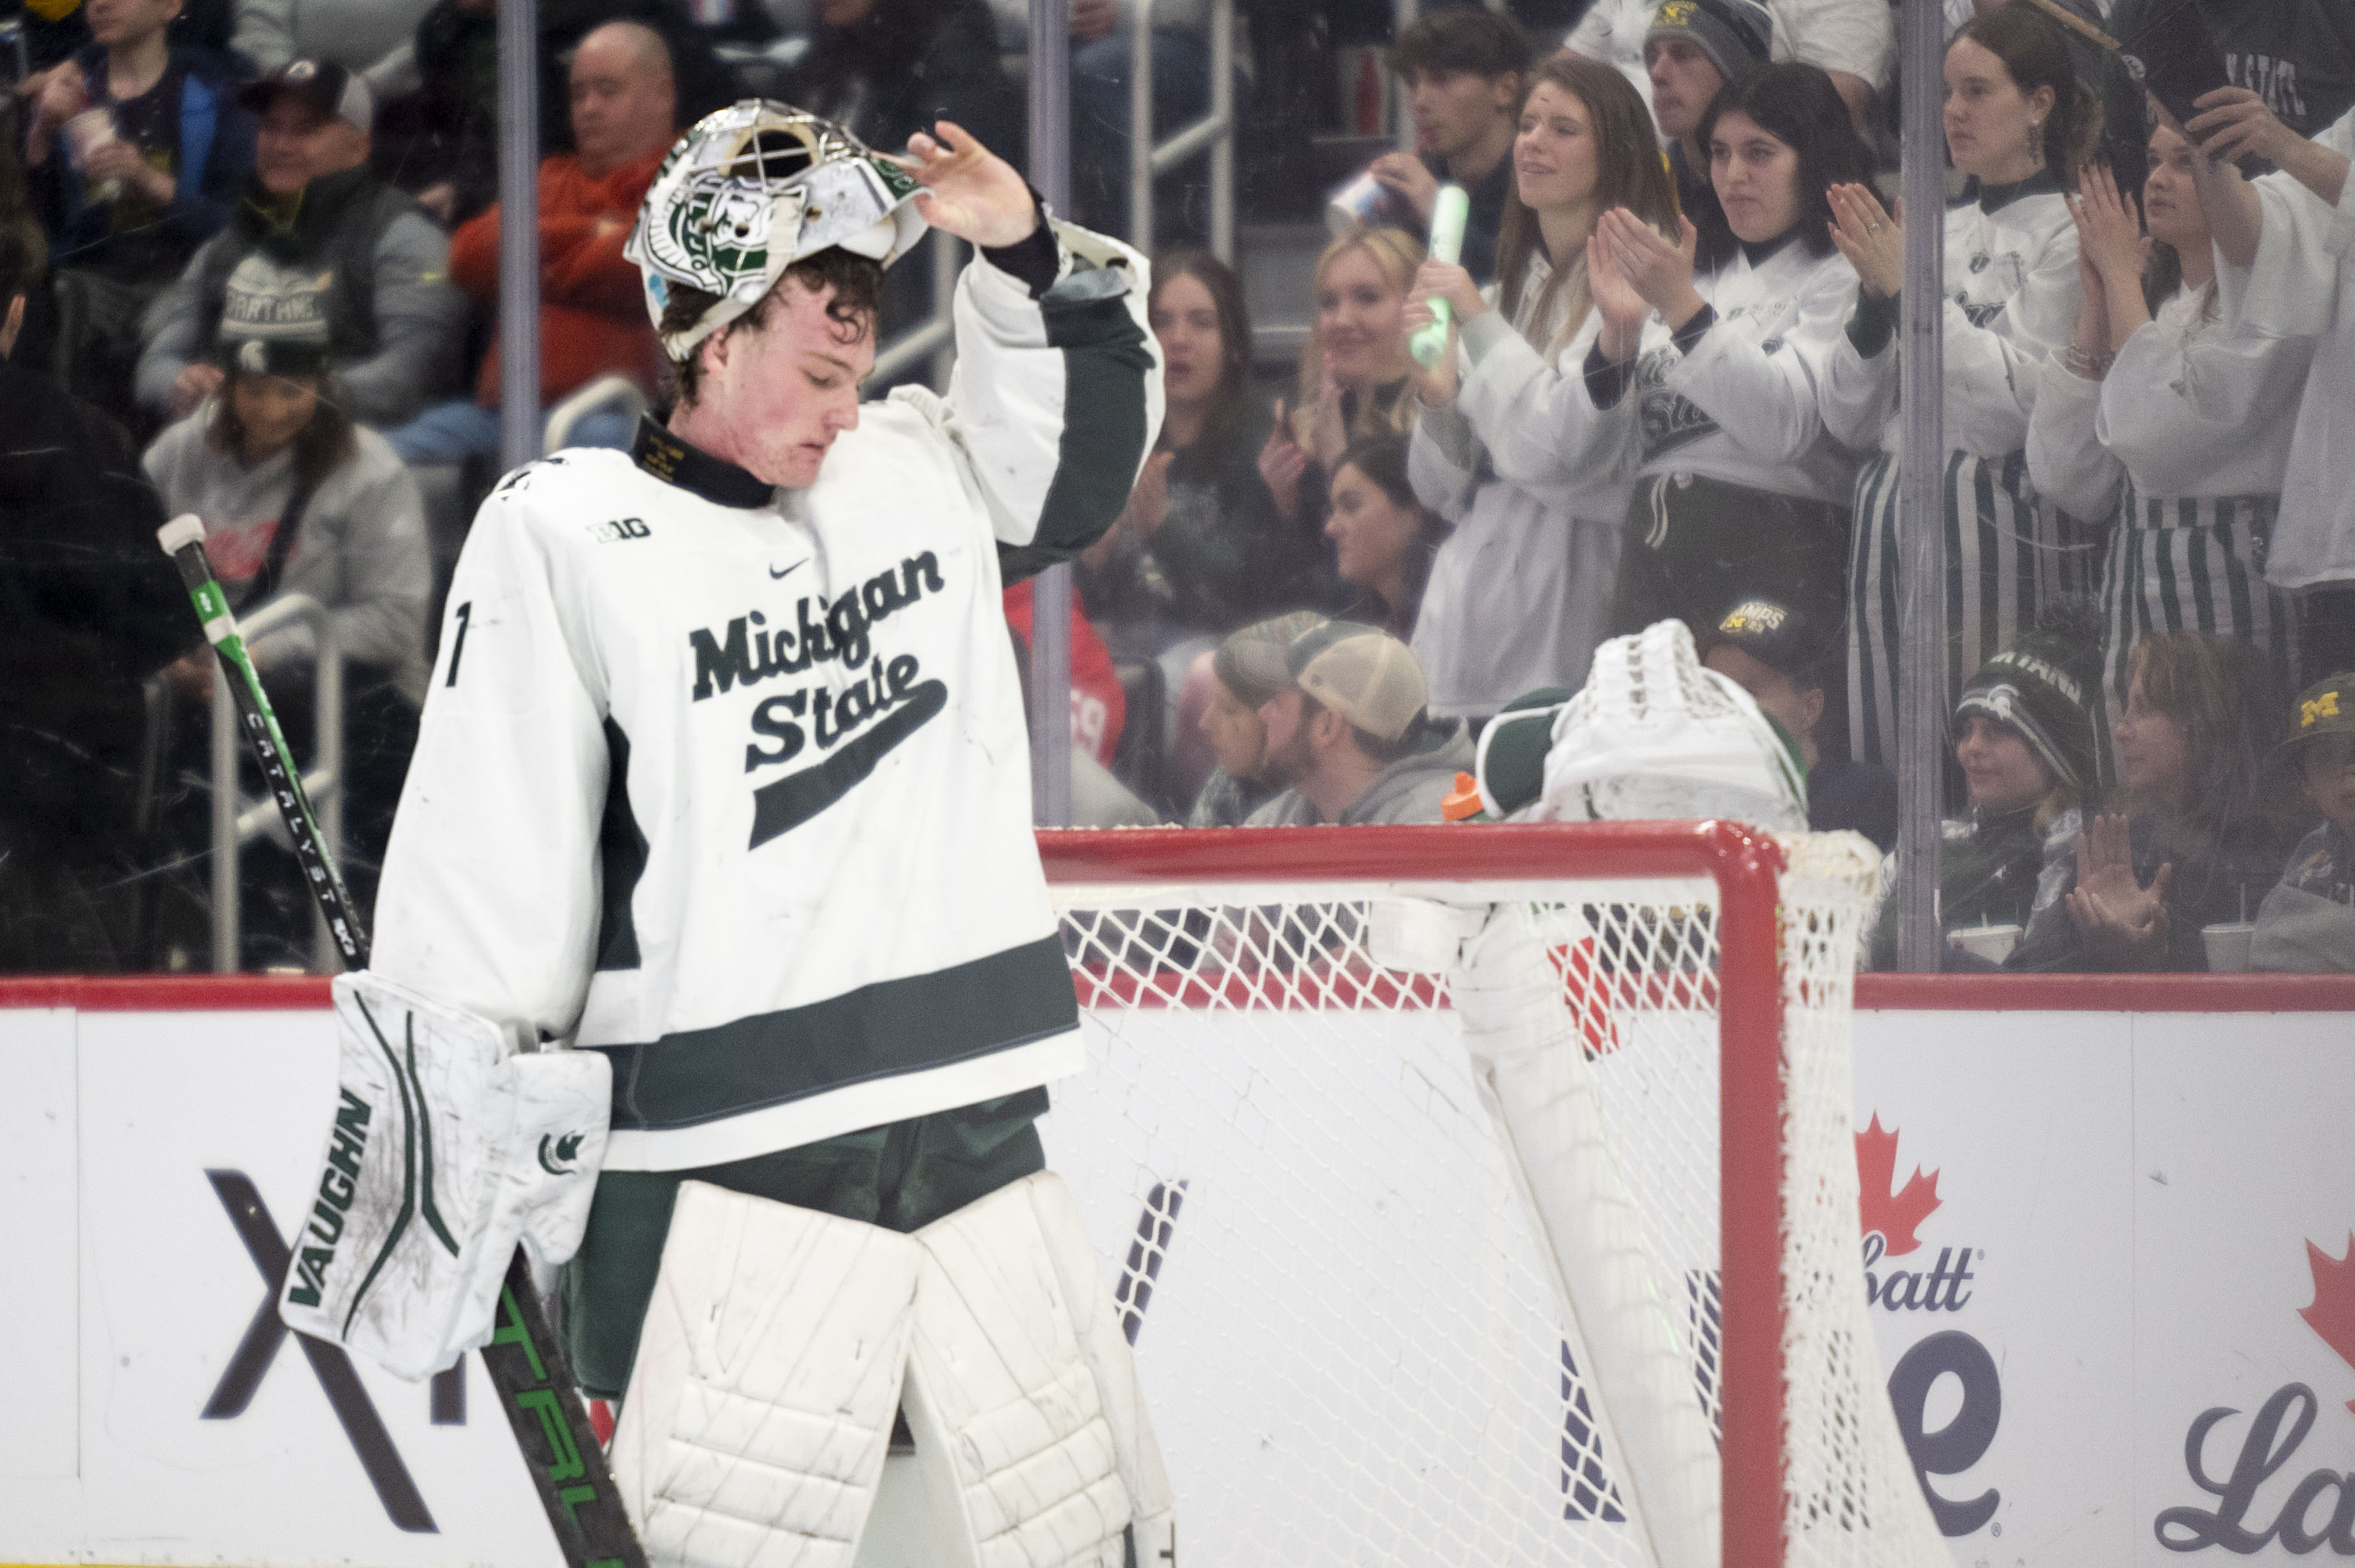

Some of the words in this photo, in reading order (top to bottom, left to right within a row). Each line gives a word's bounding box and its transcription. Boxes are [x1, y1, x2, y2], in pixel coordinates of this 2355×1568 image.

[445, 600, 472, 687] 1
[689, 550, 944, 702] Michigan
[745, 653, 919, 774] State
[2300, 691, 2339, 728] M
[246, 711, 338, 903] CATALYST
[288, 1086, 371, 1307] VAUGHN
[1863, 1234, 1975, 1312] batt
